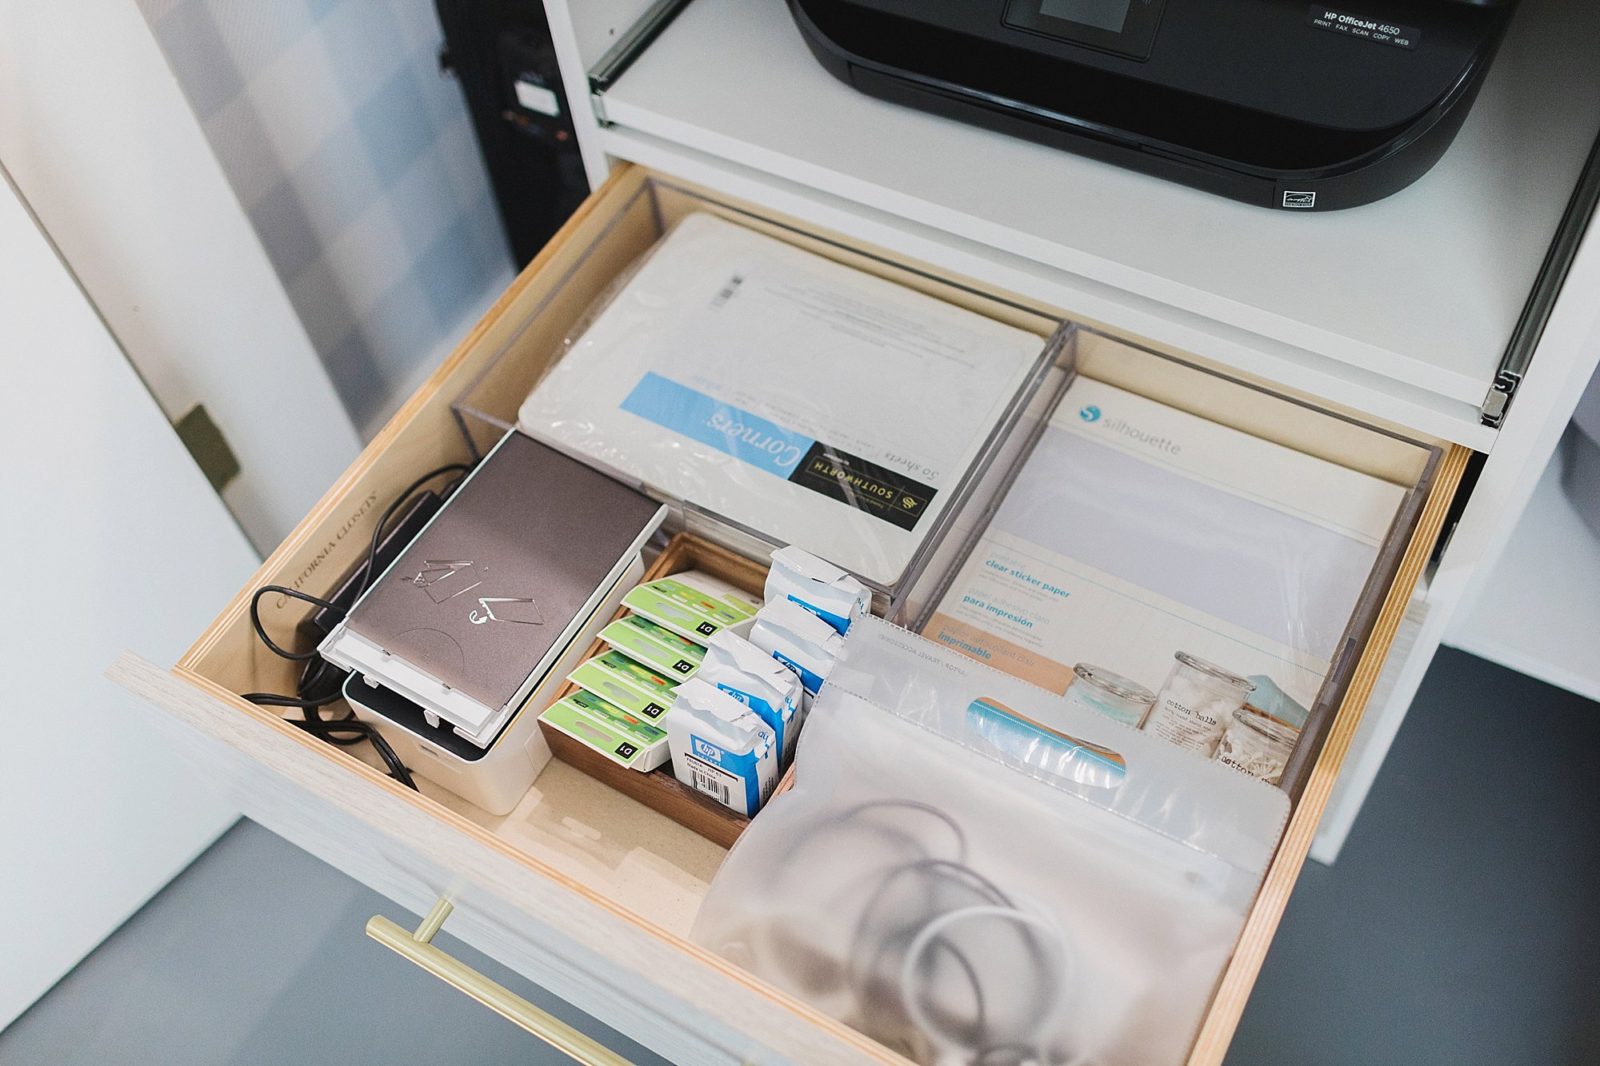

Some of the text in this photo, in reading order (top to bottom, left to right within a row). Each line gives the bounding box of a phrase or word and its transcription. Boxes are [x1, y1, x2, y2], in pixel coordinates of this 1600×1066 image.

[1313, 19, 1409, 46] PRINT FAX SCAN COPY WEB
[1324, 11, 1400, 35] HP OfficeJet 4650
[706, 412, 801, 468] Corners
[1103, 417, 1181, 455] silhouette
[883, 450, 921, 472] sheets
[814, 460, 895, 500] SOUTHWORTH
[276, 542, 336, 609] CIFORNIA
[985, 558, 1009, 573] clear
[1010, 569, 1041, 587] sticker
[1041, 581, 1071, 599] paper
[962, 594, 985, 609] para
[986, 603, 1034, 629] impresión
[700, 622, 713, 634] D1
[676, 661, 691, 672] D1
[646, 705, 660, 716] D1
[1166, 699, 1191, 716] cotton
[619, 745, 633, 755] D1
[701, 743, 715, 757] hp
